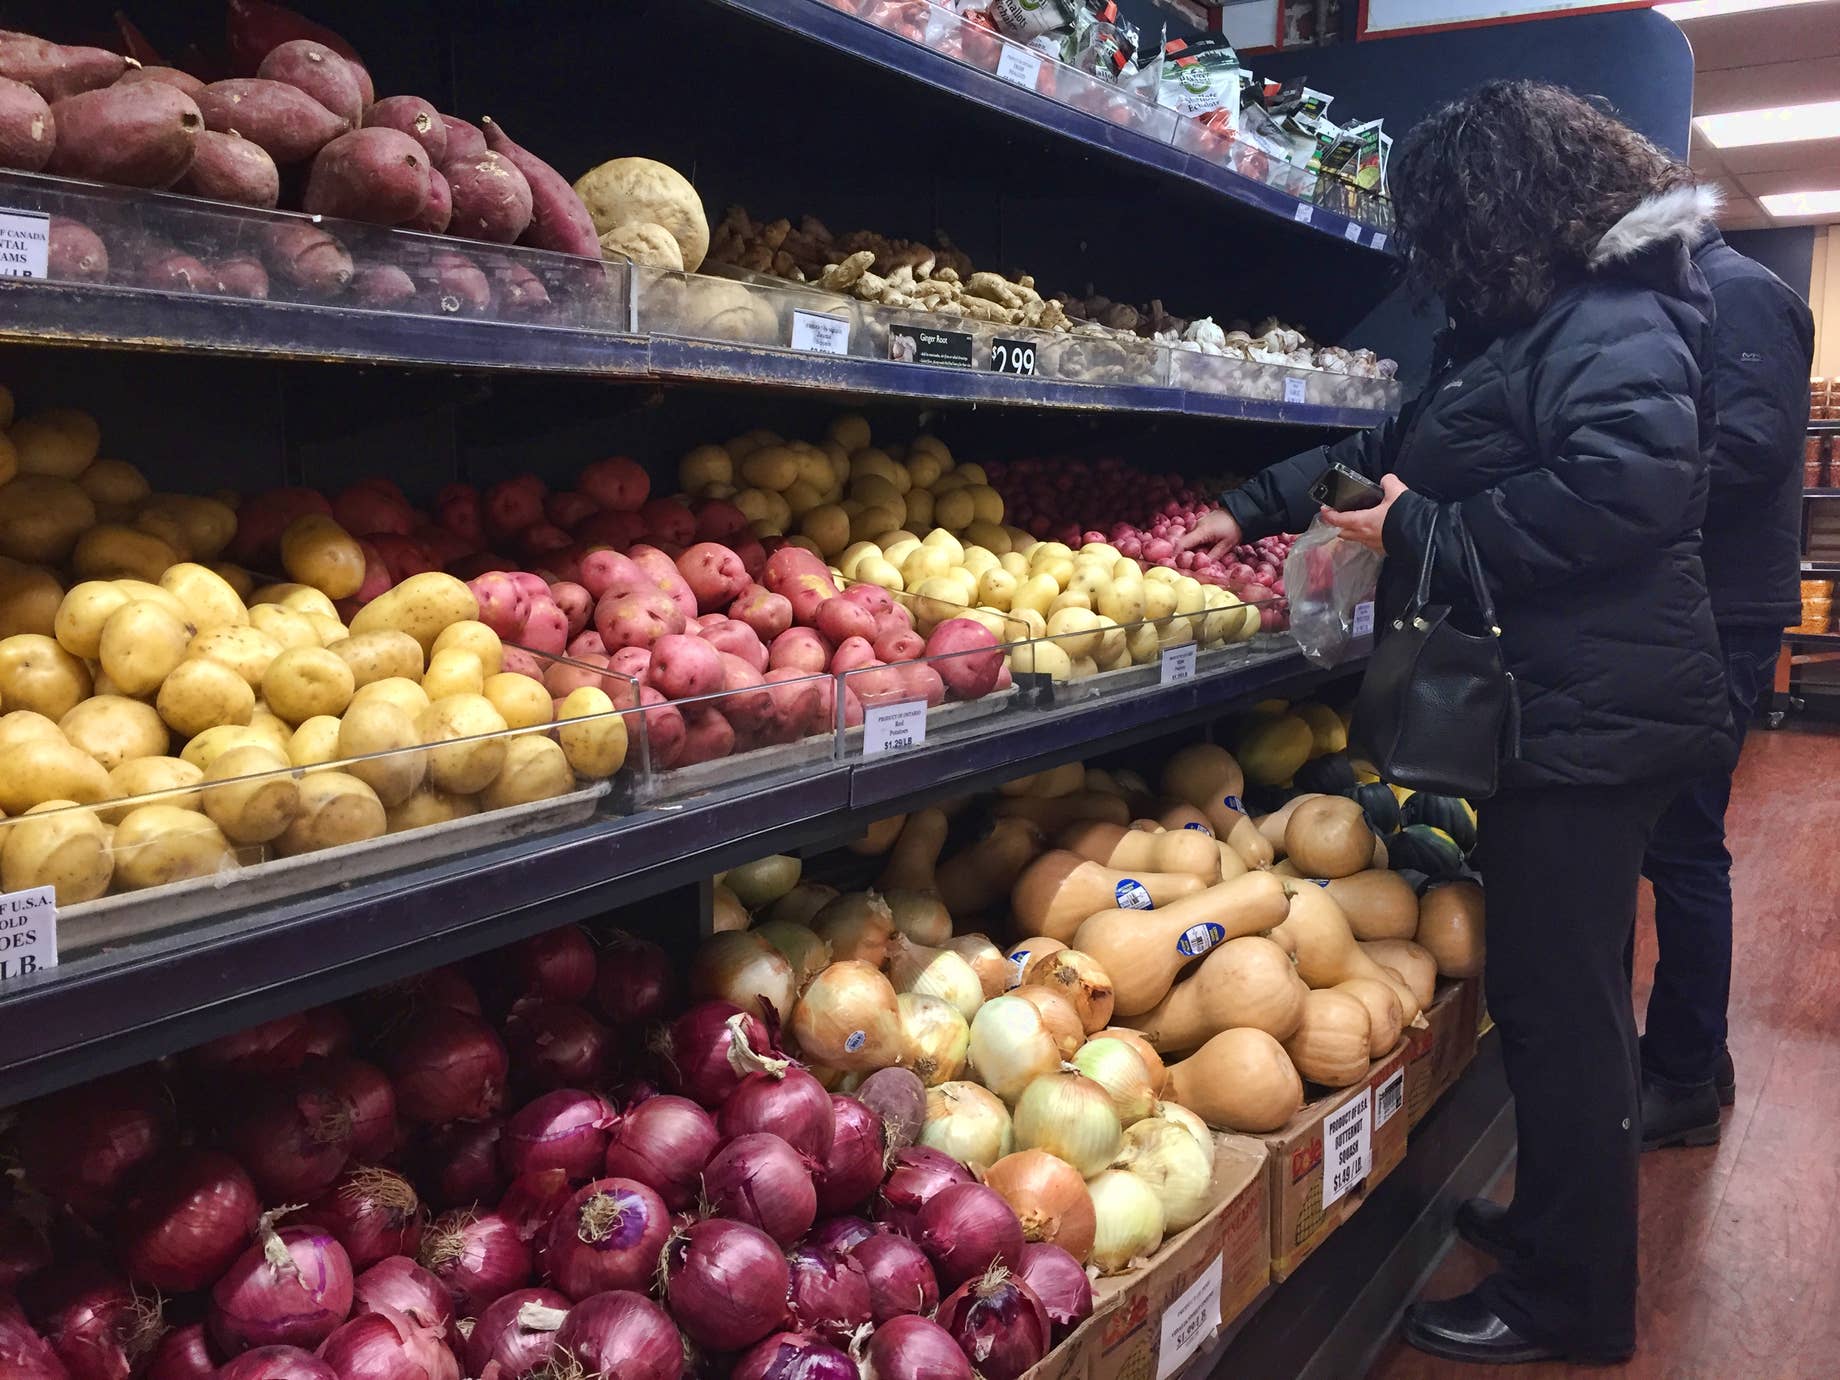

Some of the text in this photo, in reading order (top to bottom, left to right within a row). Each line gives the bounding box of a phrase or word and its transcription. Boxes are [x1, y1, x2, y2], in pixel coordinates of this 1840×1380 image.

[7, 230, 46, 241] CANADA
[920, 332, 936, 345] Ginger
[11, 895, 52, 912] U.S.A.
[1329, 1110, 1351, 1136] PRODUCT
[1351, 1105, 1357, 1120] OF
[1335, 1118, 1363, 1150] BUTTERNUT
[1338, 1139, 1359, 1165] SQUASH
